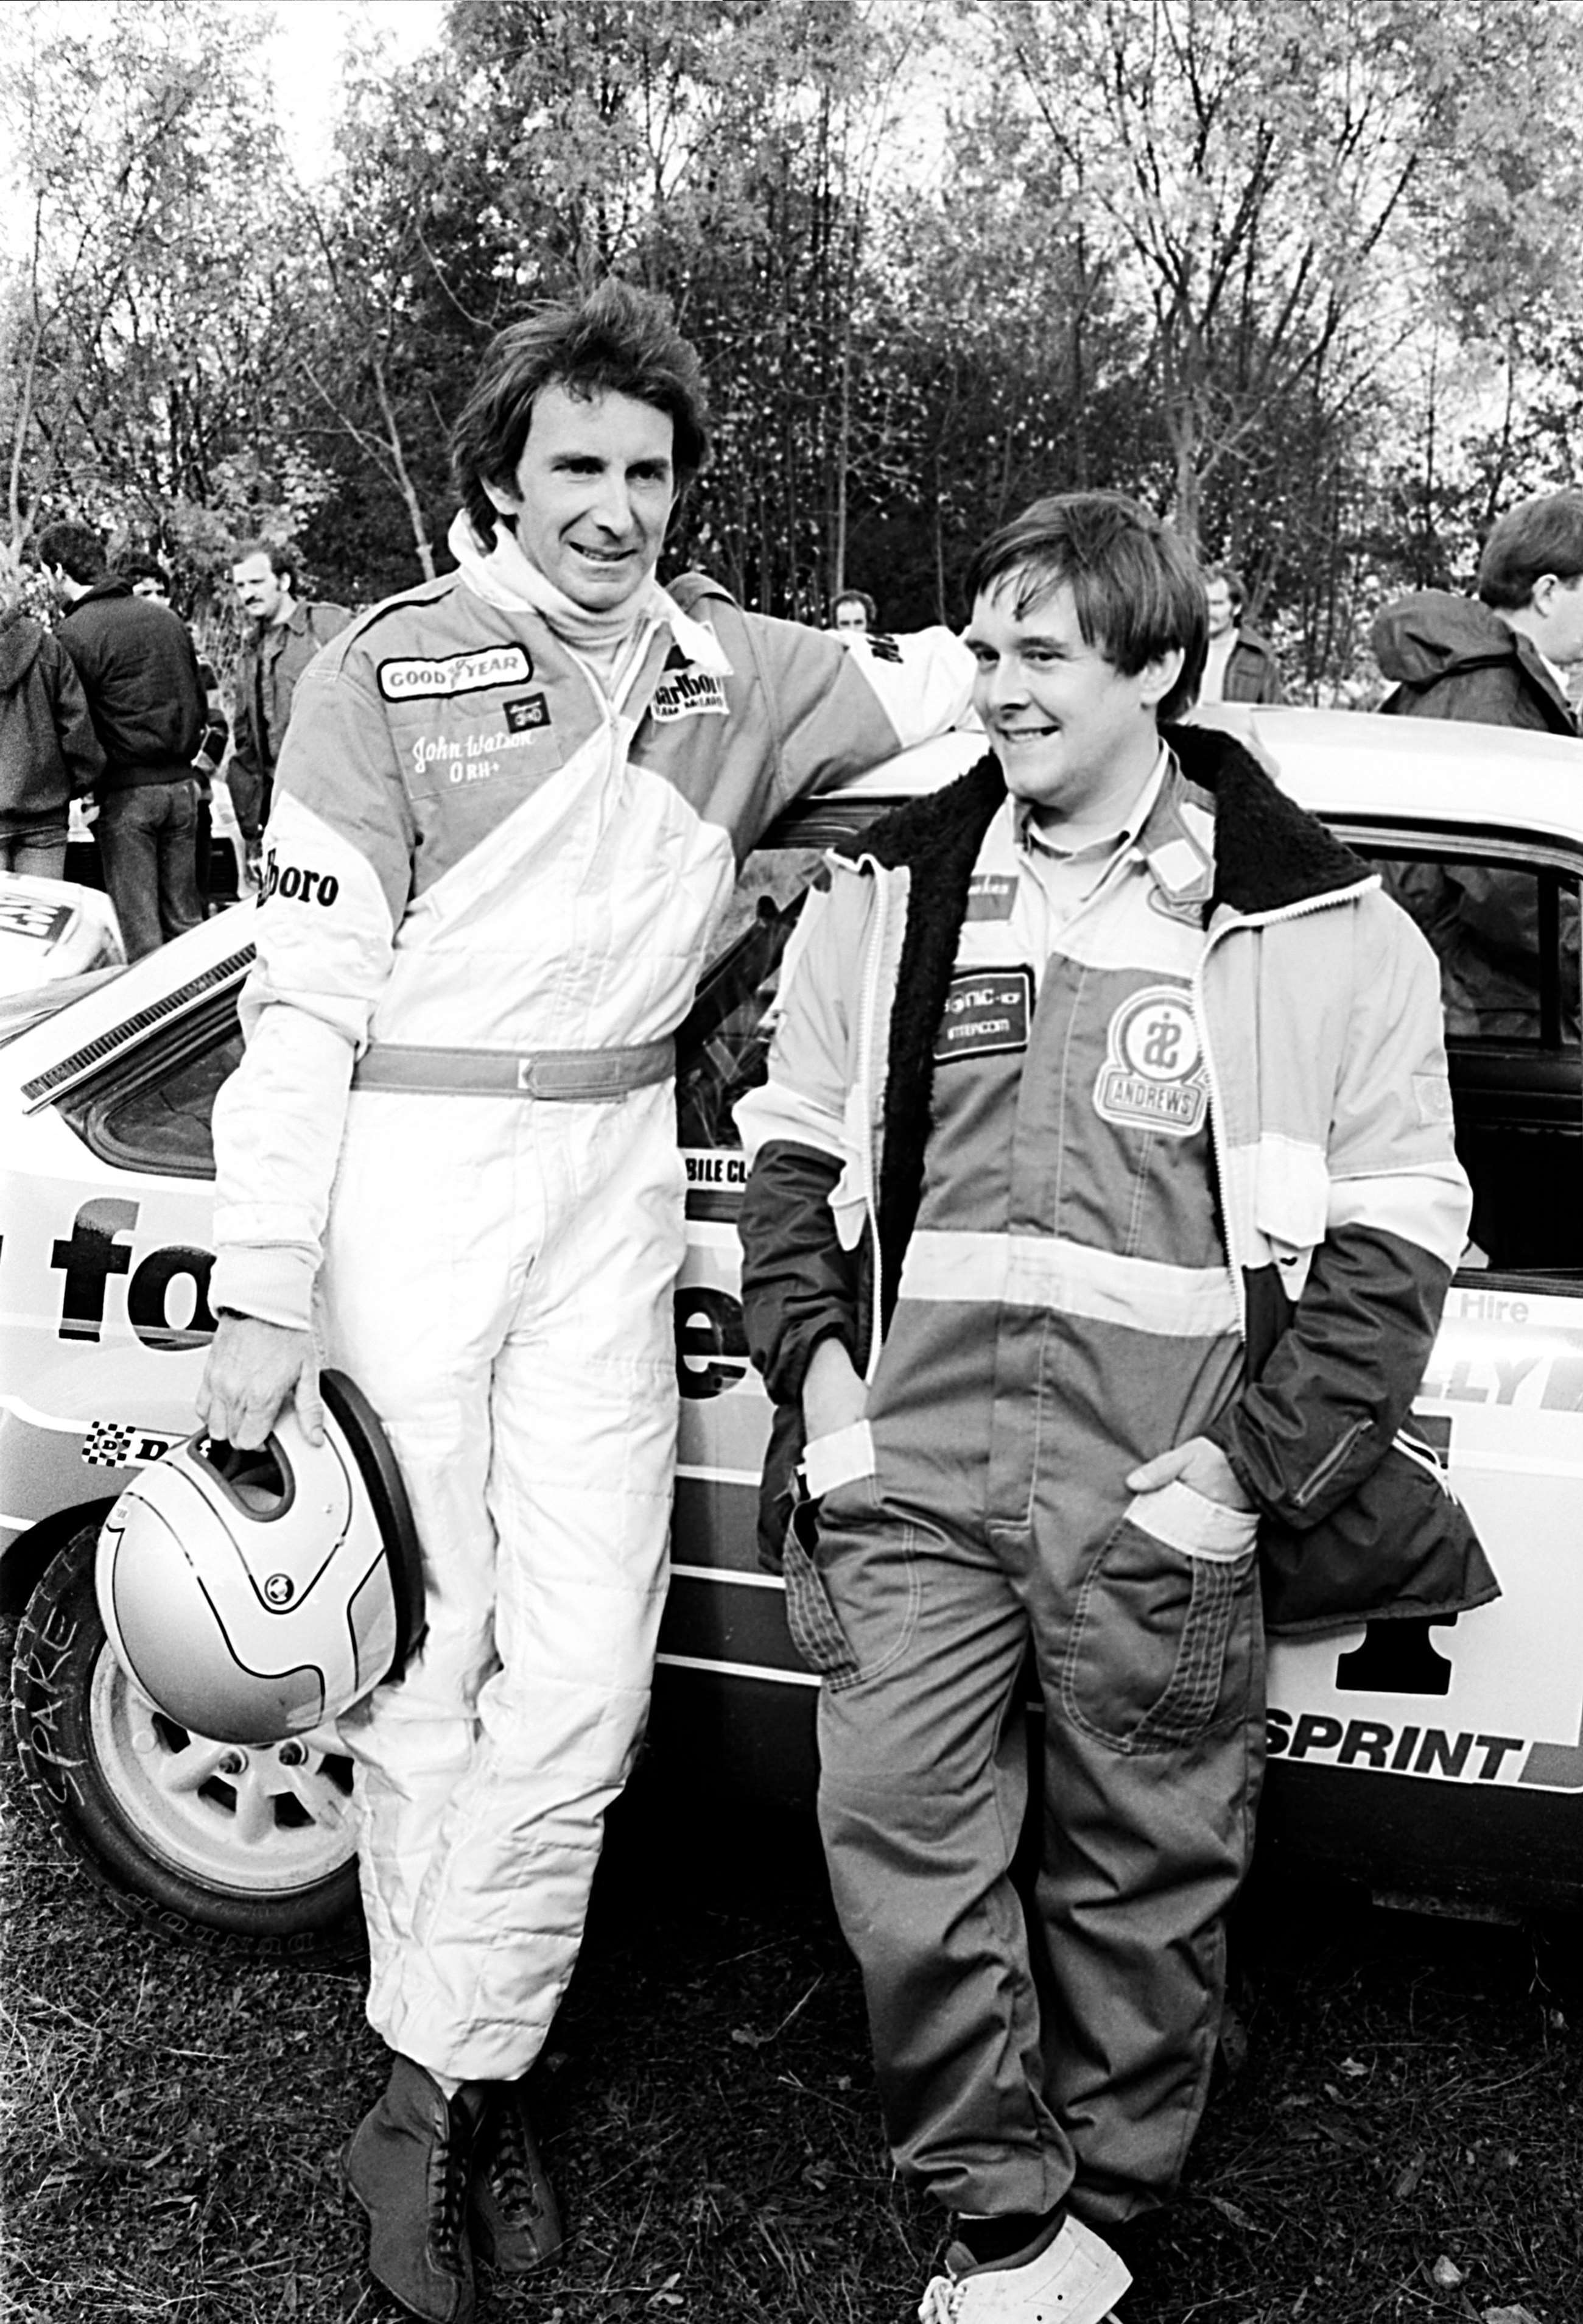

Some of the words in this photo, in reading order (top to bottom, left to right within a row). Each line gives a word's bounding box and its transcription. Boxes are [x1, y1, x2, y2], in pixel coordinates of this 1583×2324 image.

[389, 656, 518, 689] GOODYEAR
[654, 672, 722, 705] arlbor
[412, 736, 463, 773] John
[466, 731, 534, 758] Watson
[256, 848, 339, 907] boro
[1112, 1081, 1192, 1115] ANDREWS
[685, 1157, 723, 1183] BILE
[727, 1160, 753, 1183] CL
[51, 1197, 219, 1352] fo
[673, 1287, 751, 1400] e
[1461, 1292, 1529, 1323] Hire
[27, 1606, 88, 1806] SPARE
[1266, 1708, 1525, 1780] SPRINT
